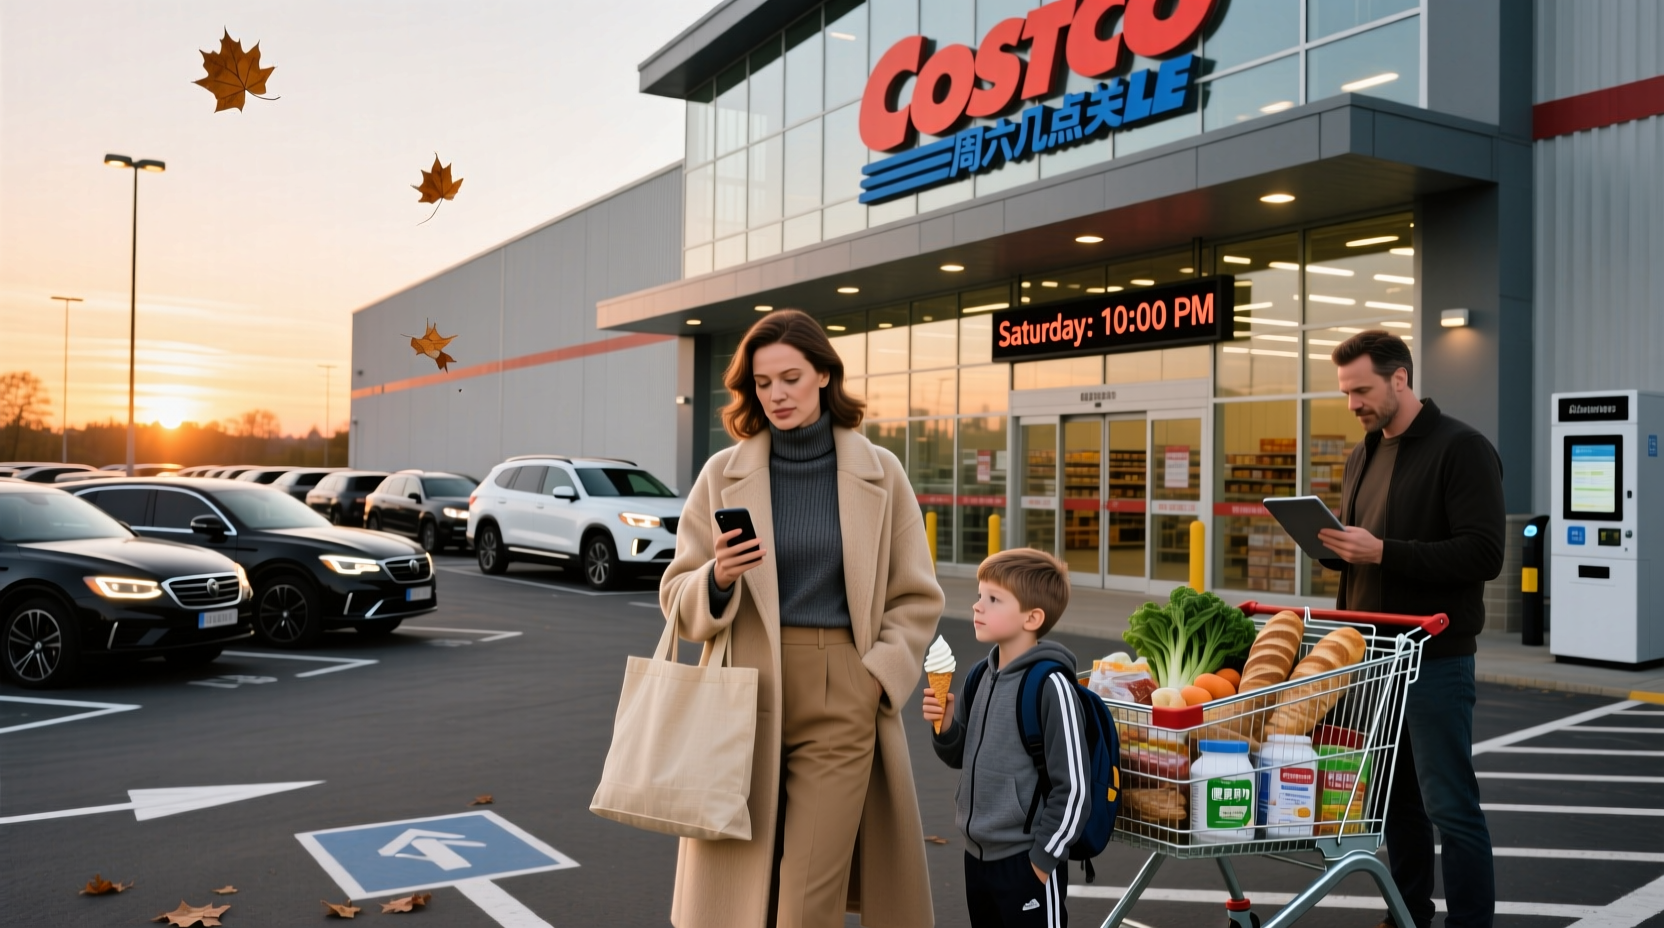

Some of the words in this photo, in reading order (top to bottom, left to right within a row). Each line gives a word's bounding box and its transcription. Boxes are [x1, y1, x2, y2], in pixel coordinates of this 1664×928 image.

[998, 312, 1093, 348] Saturday:
[1101, 300, 1167, 336] 10:00
[1174, 293, 1214, 328] PM
